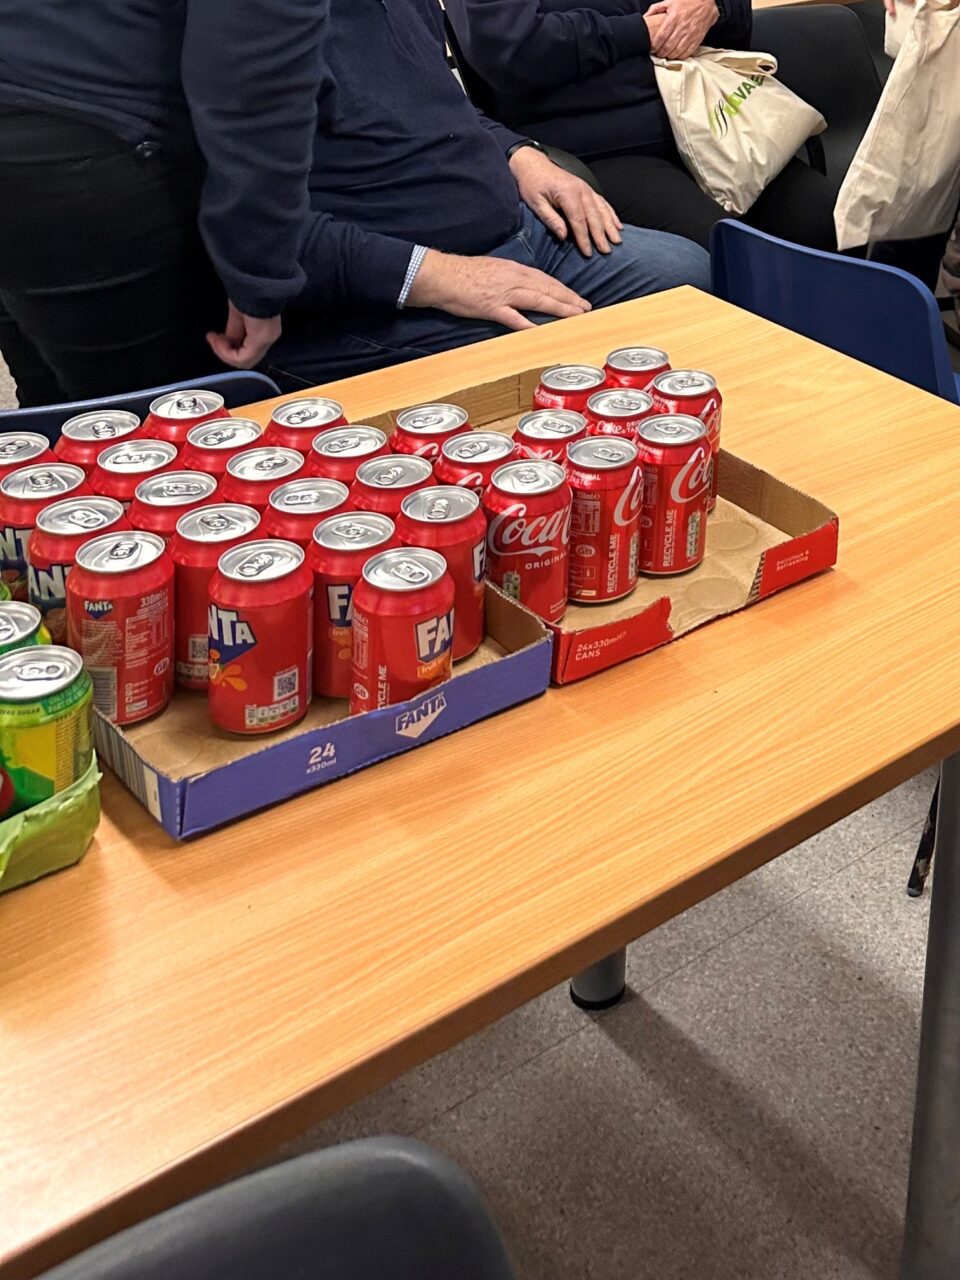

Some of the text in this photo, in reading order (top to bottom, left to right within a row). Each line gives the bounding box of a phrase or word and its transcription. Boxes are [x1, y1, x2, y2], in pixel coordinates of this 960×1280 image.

[571, 470, 601, 481] ORIGINAL
[666, 509, 674, 524] ME
[663, 525, 673, 567] RECYCLE
[525, 551, 567, 570] ORIGINAL
[606, 534, 617, 593] RECYCLE ME
[84, 601, 114, 612] FANTA
[576, 649, 601, 660] CANS
[378, 665, 388, 680] ME
[396, 694, 446, 732] FANTA
[309, 742, 336, 764] 24
